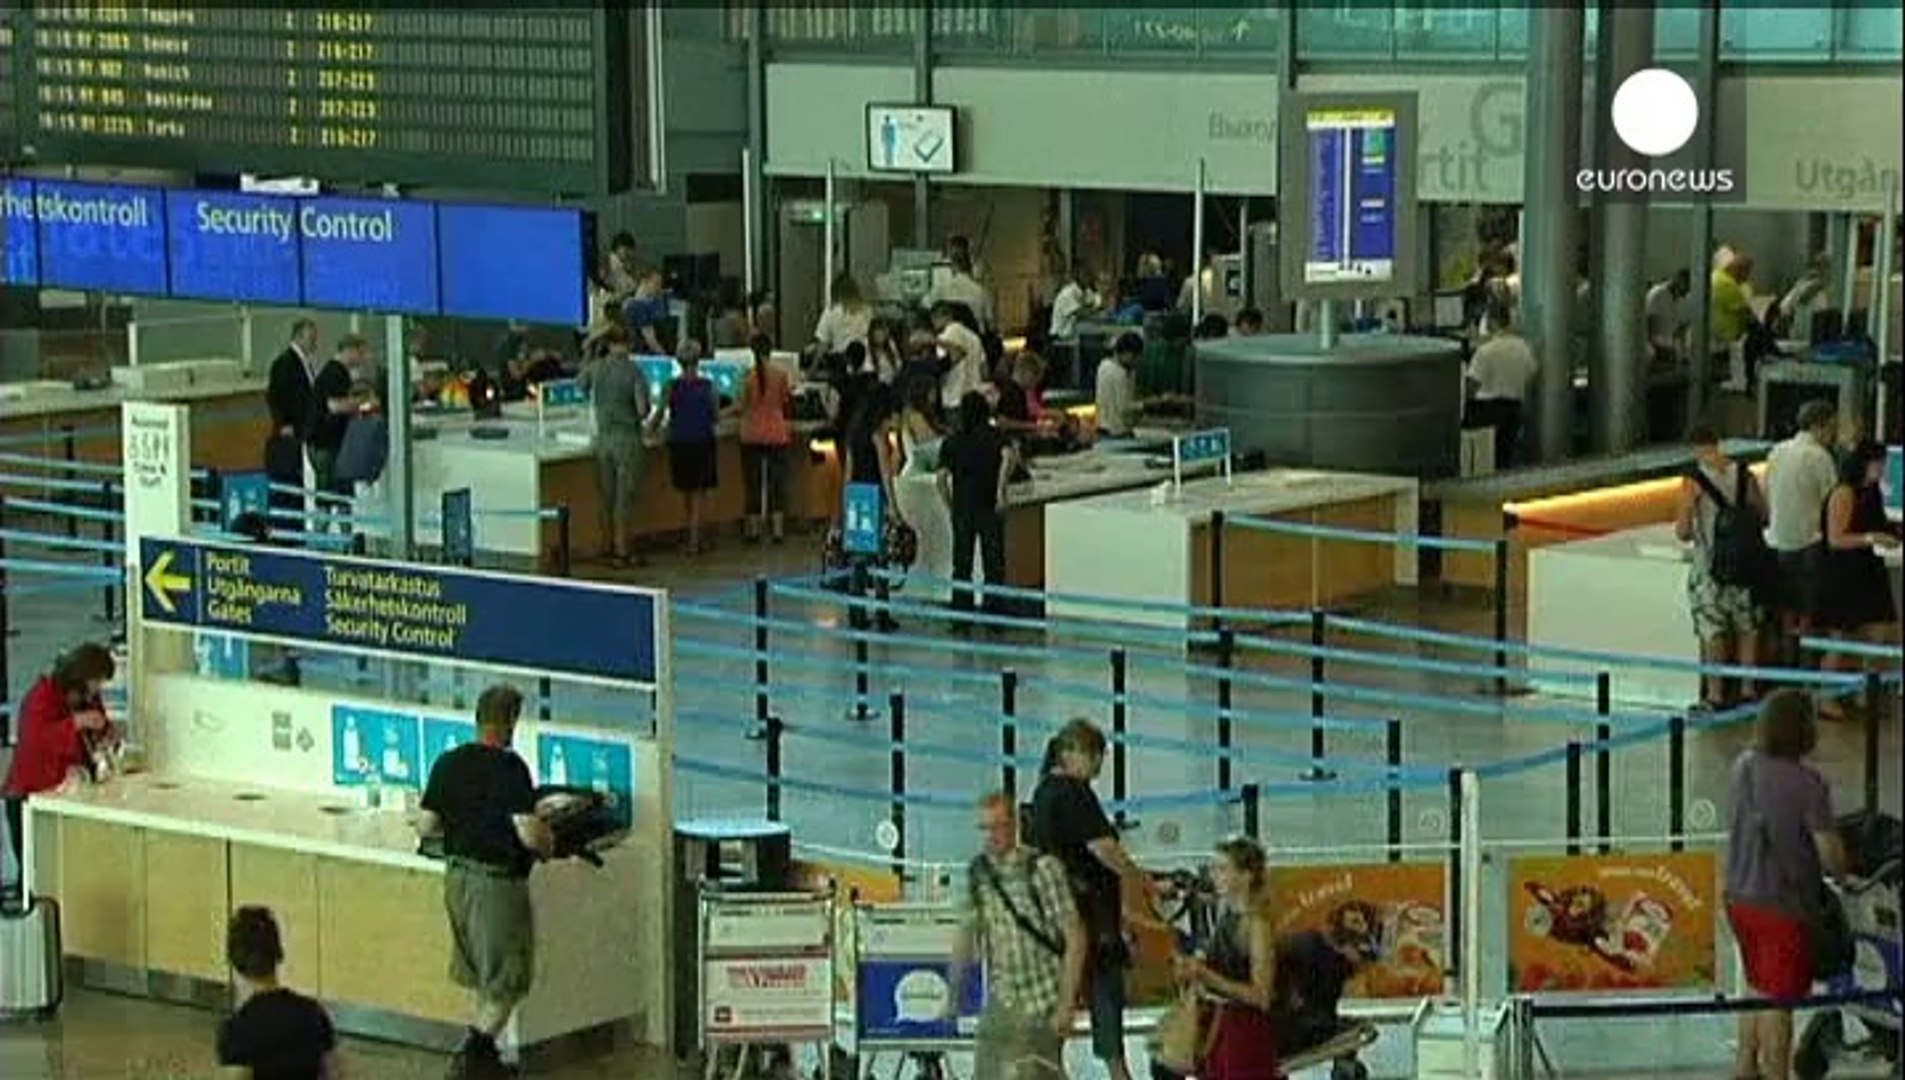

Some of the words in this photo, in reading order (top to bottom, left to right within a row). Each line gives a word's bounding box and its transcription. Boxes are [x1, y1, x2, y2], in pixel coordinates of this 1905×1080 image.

[197, 201, 292, 243] Security
[300, 206, 393, 243] Control
[206, 553, 251, 576] Portit
[207, 576, 301, 607] Utgångarna
[324, 566, 441, 599] Turvatarkastus
[207, 600, 252, 624] Gates
[325, 613, 390, 646] Security
[391, 622, 455, 649] Control
